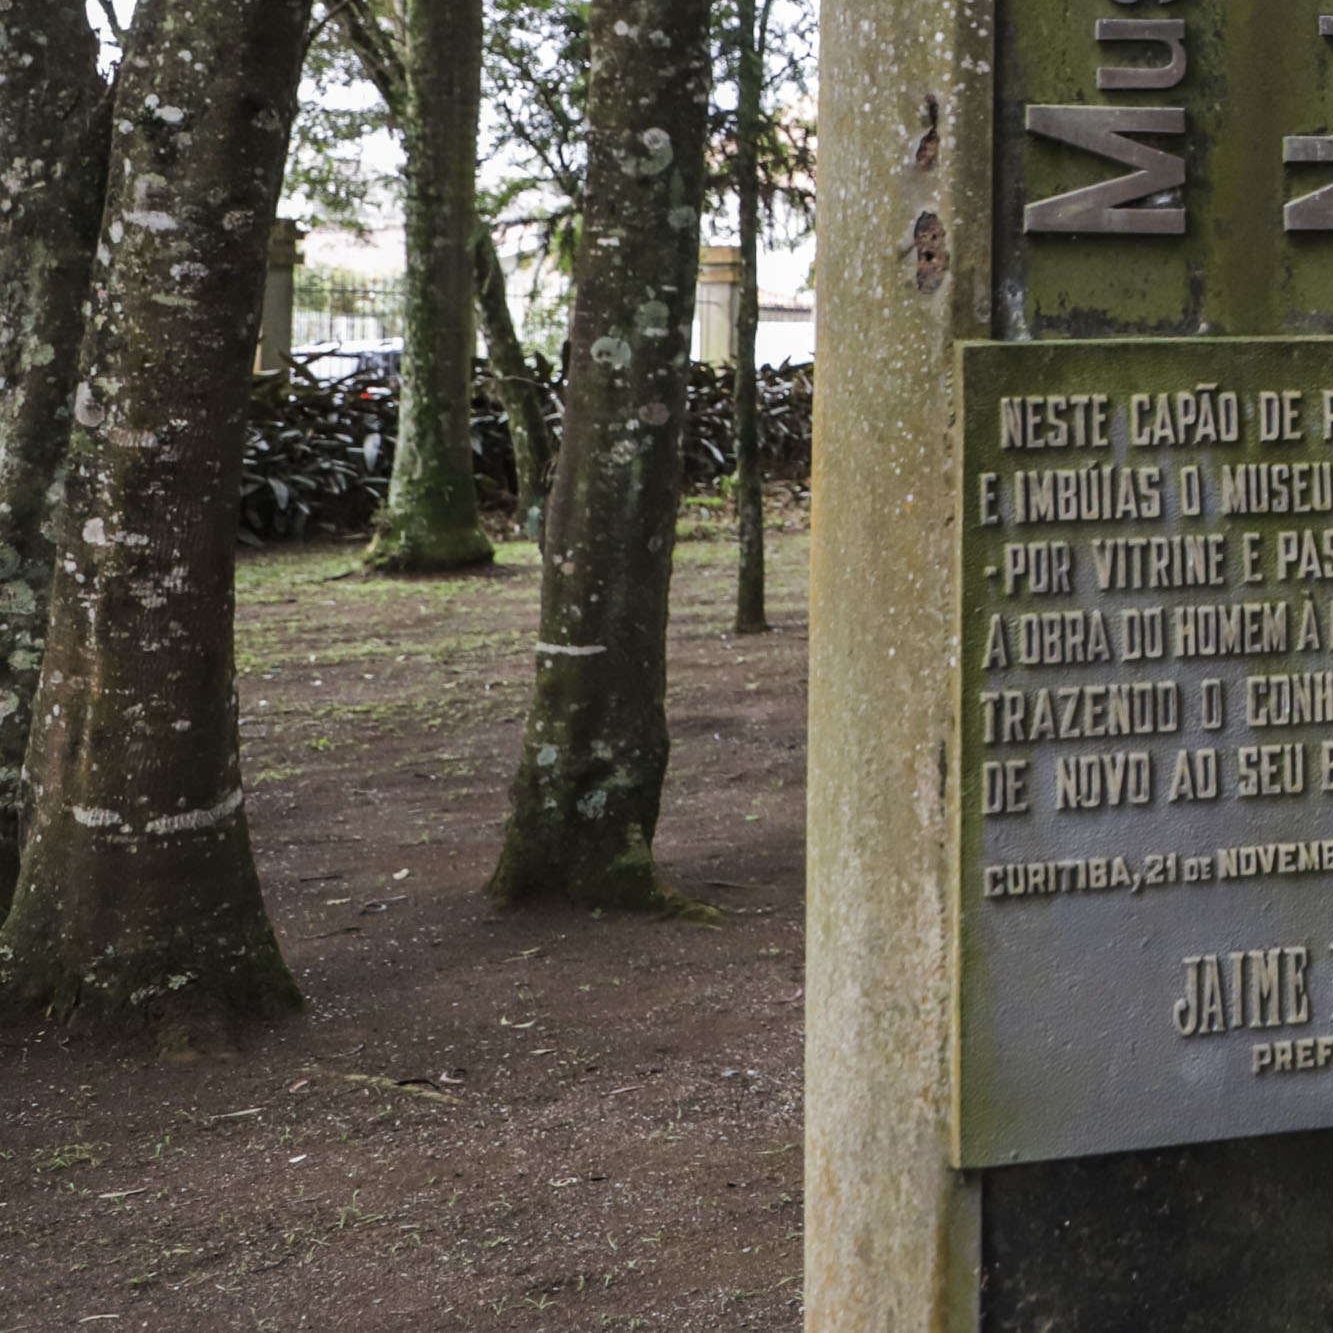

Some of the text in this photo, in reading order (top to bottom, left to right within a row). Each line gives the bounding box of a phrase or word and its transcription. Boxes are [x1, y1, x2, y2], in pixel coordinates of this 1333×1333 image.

[1001, 394, 1108, 449] NESTE
[1131, 383, 1239, 446] CAPÃO
[1260, 391, 1302, 441] DE
[980, 472, 998, 525] E
[1015, 461, 1161, 522] IMBÚIAS
[1181, 466, 1199, 516] O
[1221, 462, 1332, 515] MUSEU
[1093, 534, 1224, 590] VITRINE
[1244, 532, 1263, 582] E
[983, 609, 1007, 668] A
[1019, 609, 1110, 665] OBRA
[1122, 607, 1164, 660] DO
[1174, 601, 1288, 658] HOMEM
[980, 680, 1178, 743] TRAZENDO
[1202, 678, 1222, 729] O
[982, 759, 1028, 814] DE
[1056, 751, 1150, 810] NOVO
[1168, 748, 1218, 802] AO
[1238, 742, 1304, 796] SEU
[1173, 946, 1310, 1036] JAIME
